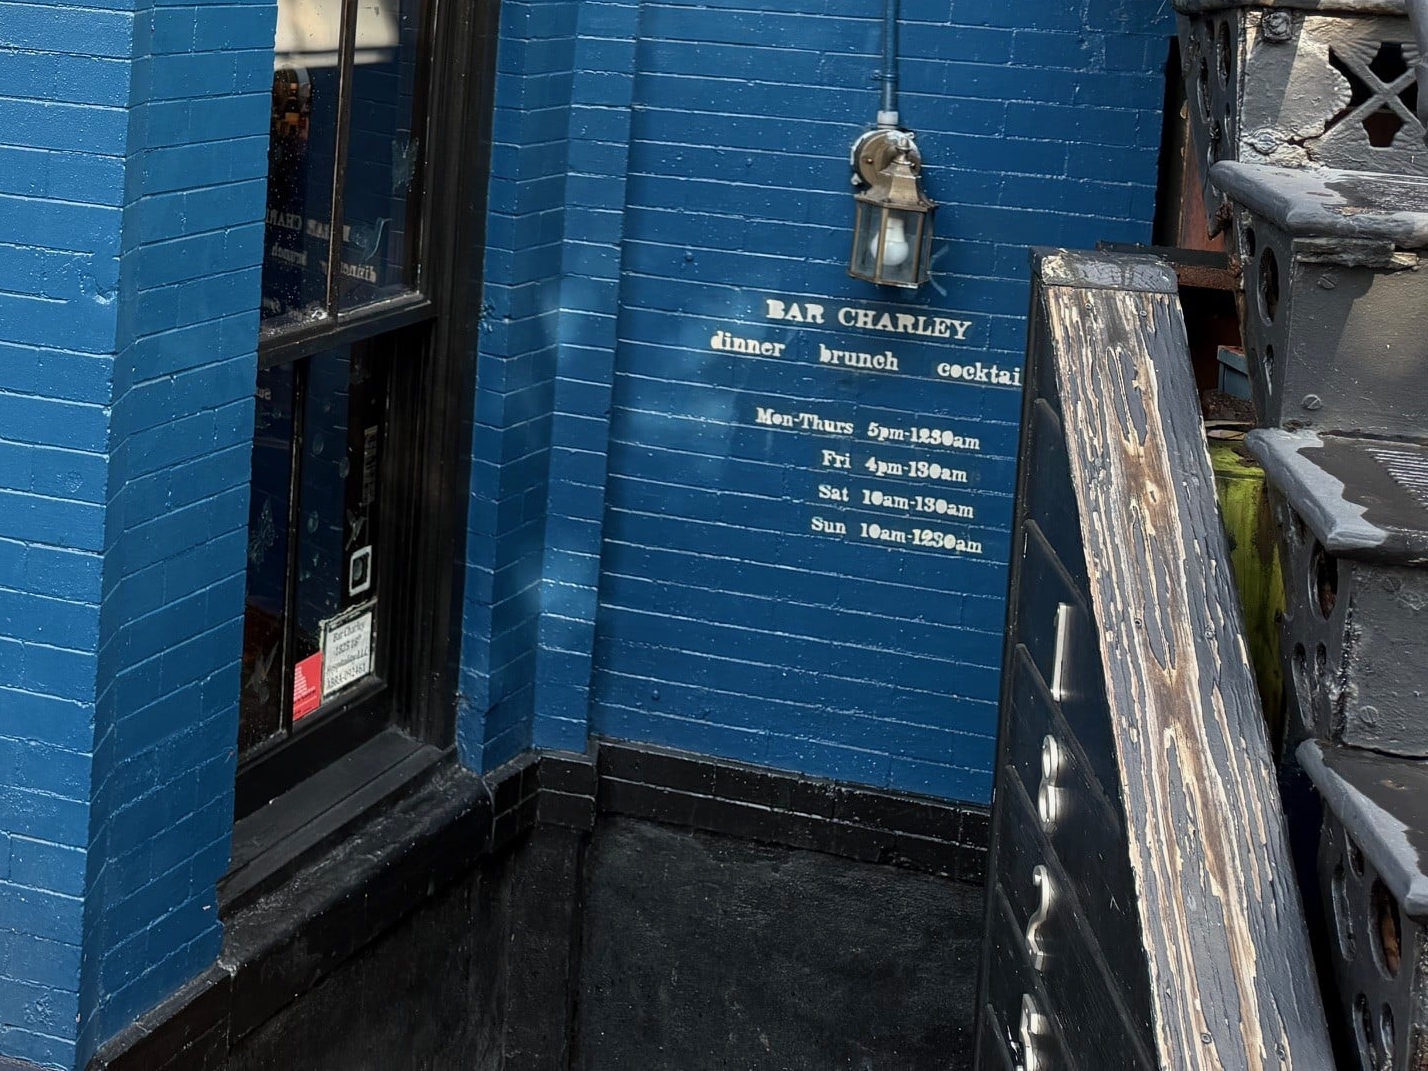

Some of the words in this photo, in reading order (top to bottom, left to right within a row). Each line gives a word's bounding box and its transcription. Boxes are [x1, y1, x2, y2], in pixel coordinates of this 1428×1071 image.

[765, 298, 825, 325] BAR
[838, 307, 972, 340] CHARLEY
[710, 331, 786, 358] dinner
[818, 343, 899, 372] brunch
[755, 407, 854, 436] Mon-Thurs
[866, 422, 981, 451] 5pm-1230am
[821, 449, 852, 470] Fri
[864, 457, 968, 483] 4pm-130am
[818, 484, 850, 503] Sat
[862, 489, 975, 519] 10am-130am
[811, 516, 847, 536] Sun
[860, 522, 983, 554] 10am-1230am
